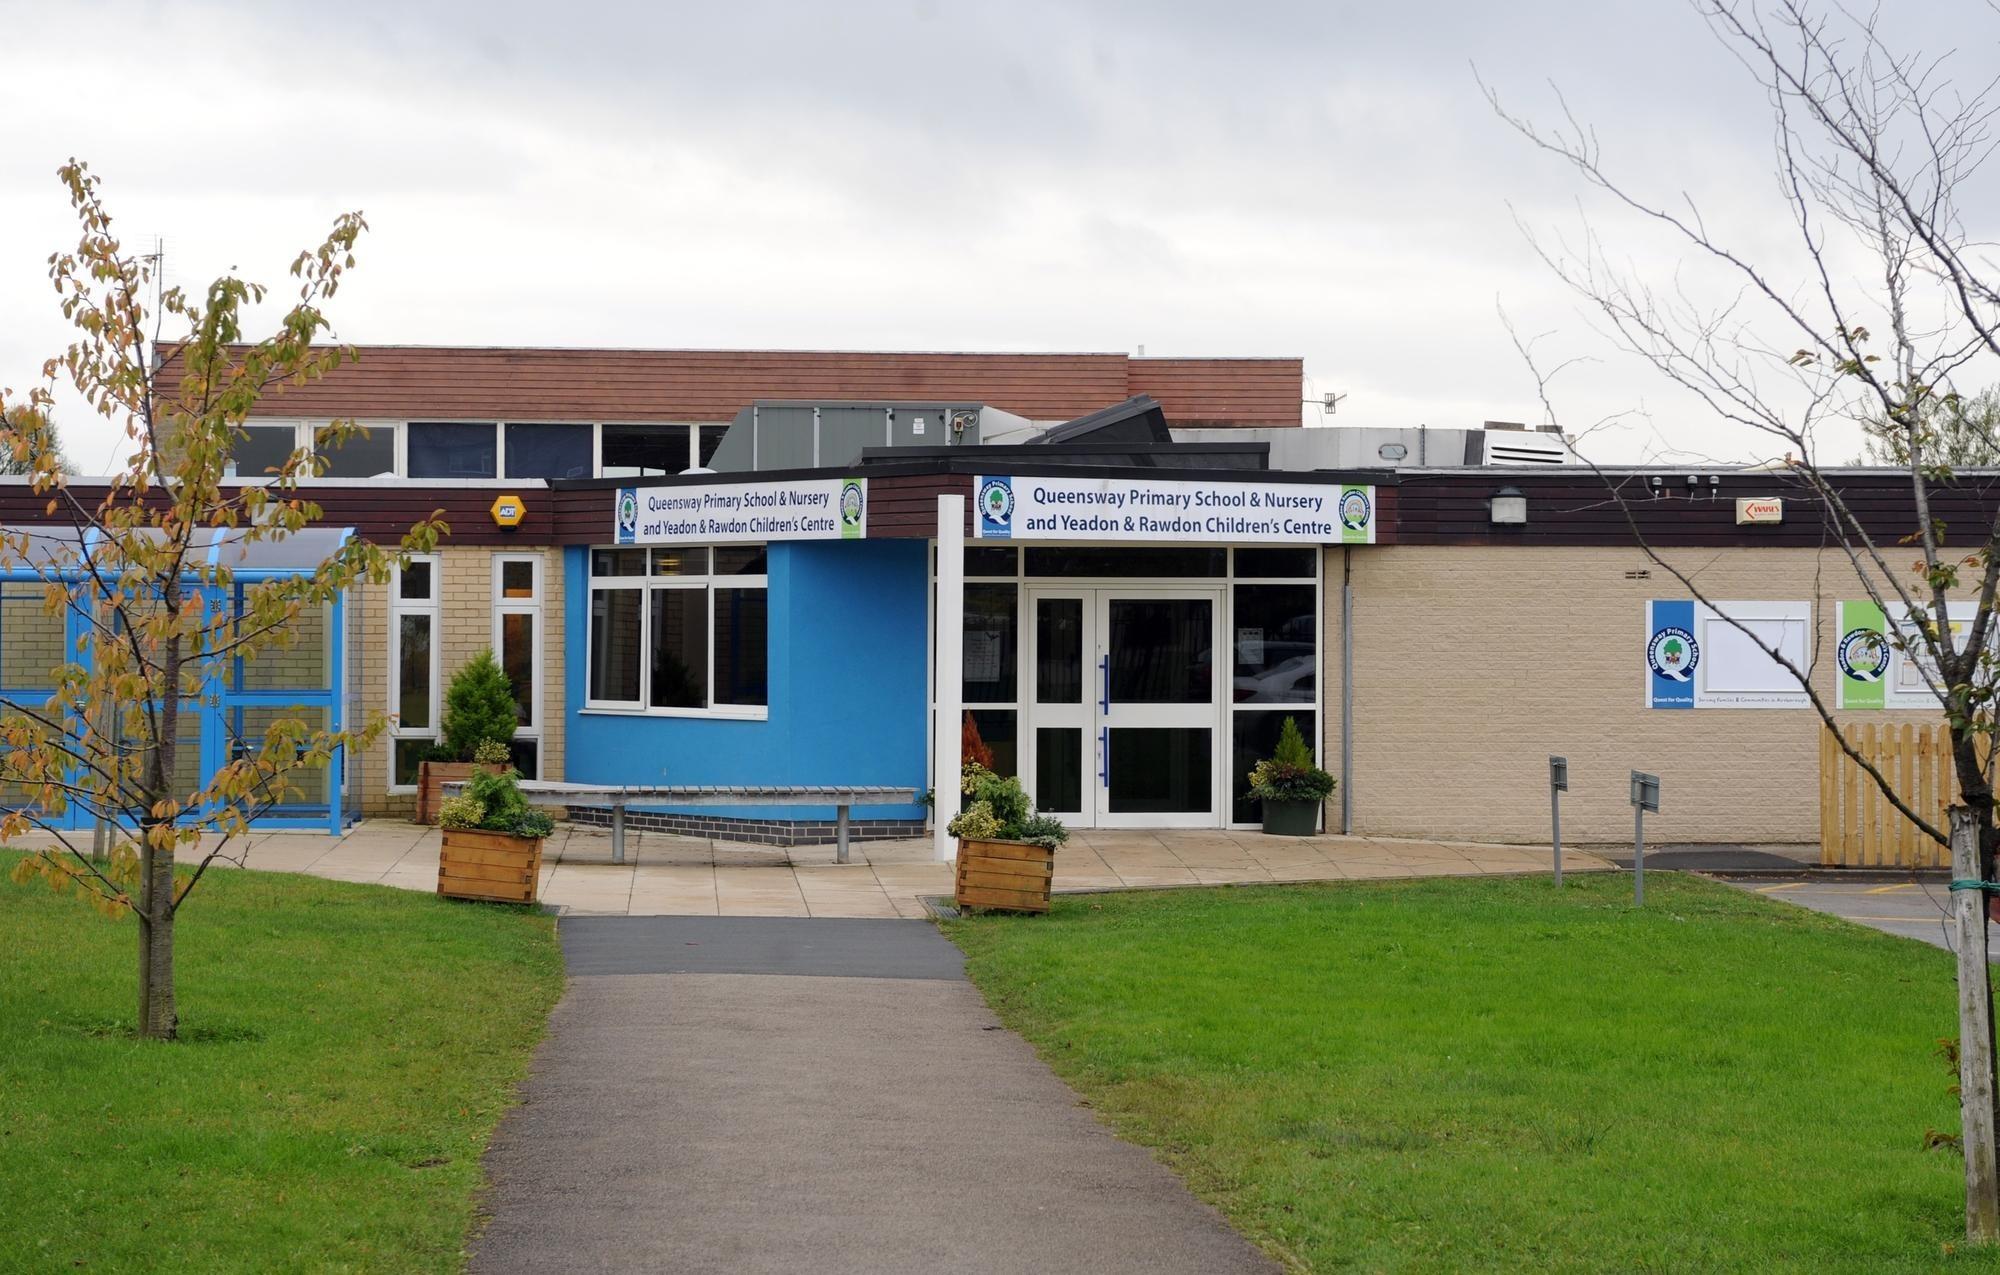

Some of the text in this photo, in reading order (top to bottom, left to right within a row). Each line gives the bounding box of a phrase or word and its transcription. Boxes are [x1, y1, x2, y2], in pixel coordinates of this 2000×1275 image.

[648, 496, 702, 512] Queensway
[704, 493, 741, 511] Primary
[743, 490, 777, 507] School
[779, 491, 787, 506] &
[789, 490, 830, 508] Nursery
[1034, 487, 1323, 512] Queensway Primary School & Nursery
[500, 506, 516, 517] ADT
[643, 515, 835, 535] and Yeadon & Rawdon Children's Centre
[1026, 514, 1332, 535] and Yeadon & Rawdon Children's Centre
[1649, 628, 1700, 670] Queensway Primary School
